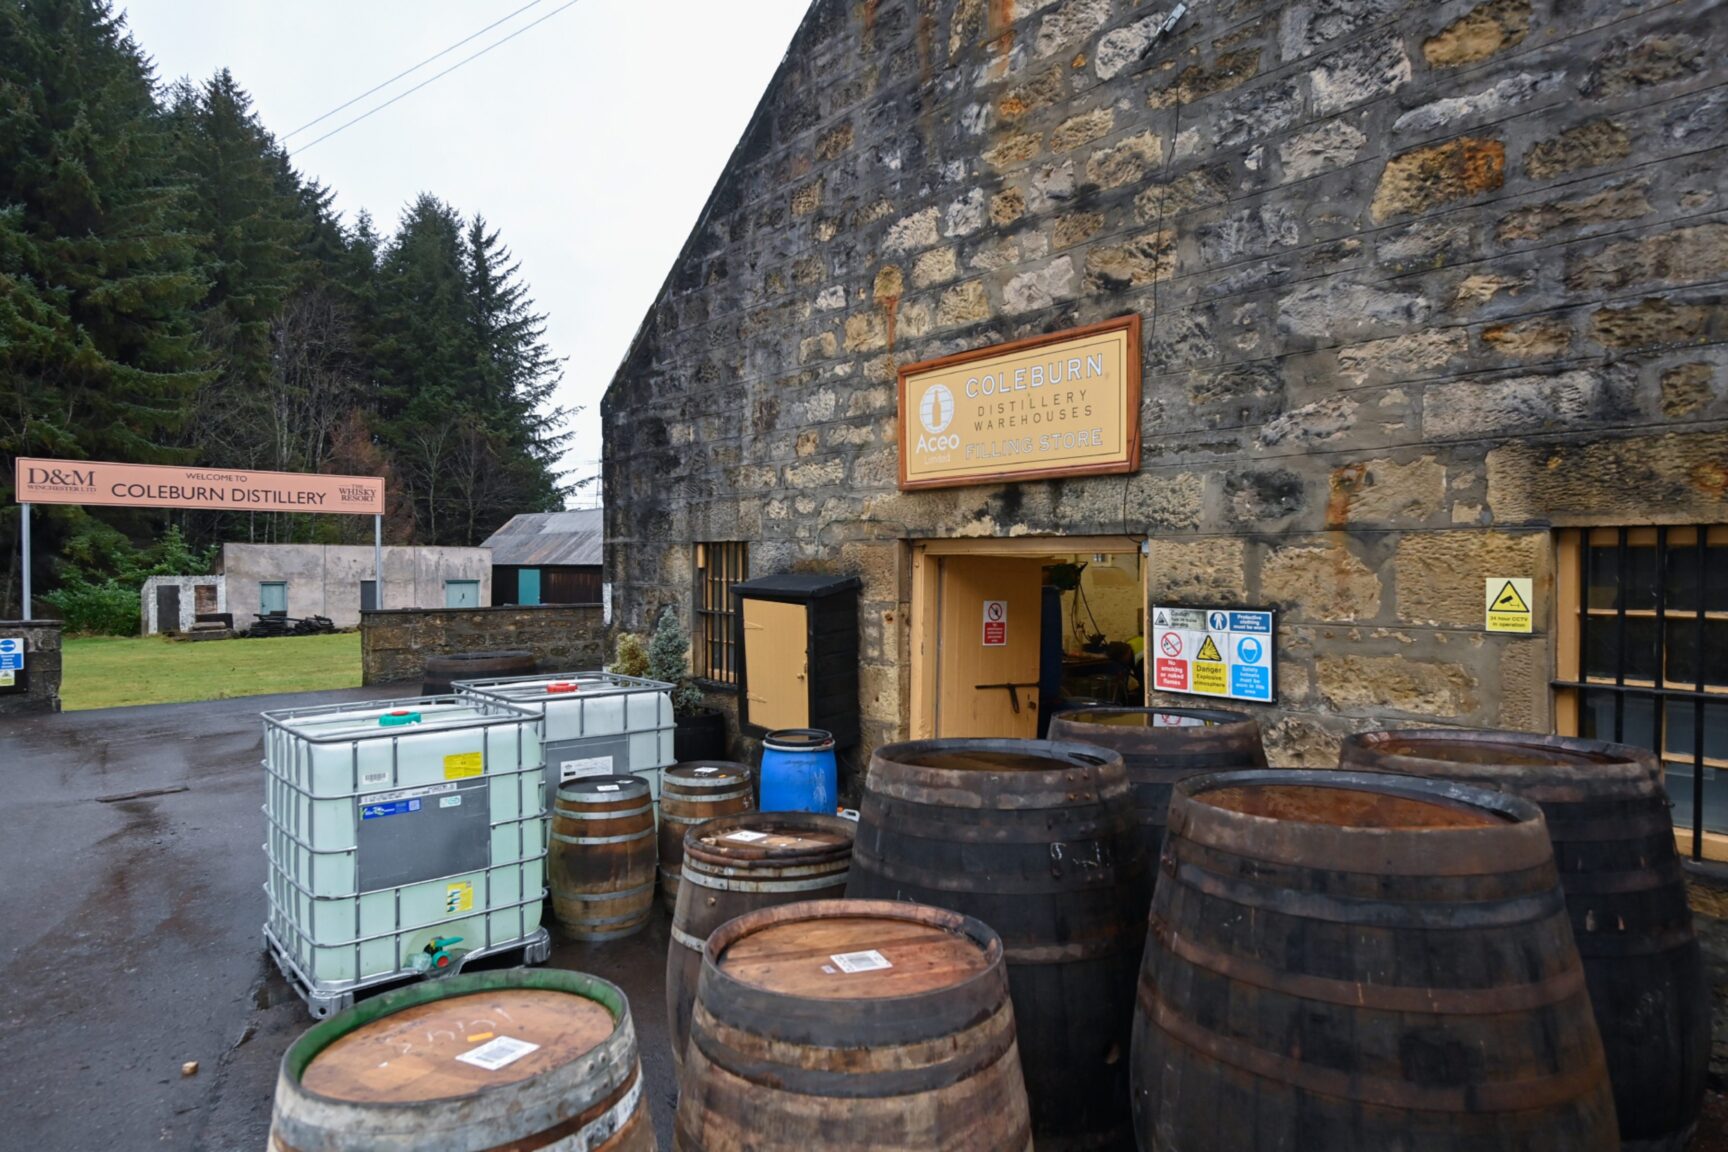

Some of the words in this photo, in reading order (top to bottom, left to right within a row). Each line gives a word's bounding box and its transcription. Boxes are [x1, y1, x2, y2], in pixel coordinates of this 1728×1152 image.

[965, 353, 1103, 399] COLEBURN
[977, 389, 1087, 417] DISTILLERY
[974, 405, 1092, 431] WAREHOUSES
[916, 434, 960, 454] Aceo
[965, 437, 1032, 460] FILLING
[1039, 428, 1103, 450] STORE
[27, 468, 96, 486] D&M
[186, 473, 233, 482] WELCOME
[235, 475, 248, 483] TO
[111, 483, 224, 501] COLEBURN
[232, 488, 327, 505] DISTILLERY
[339, 488, 376, 497] WHISKY
[1196, 665, 1221, 674] Danger
